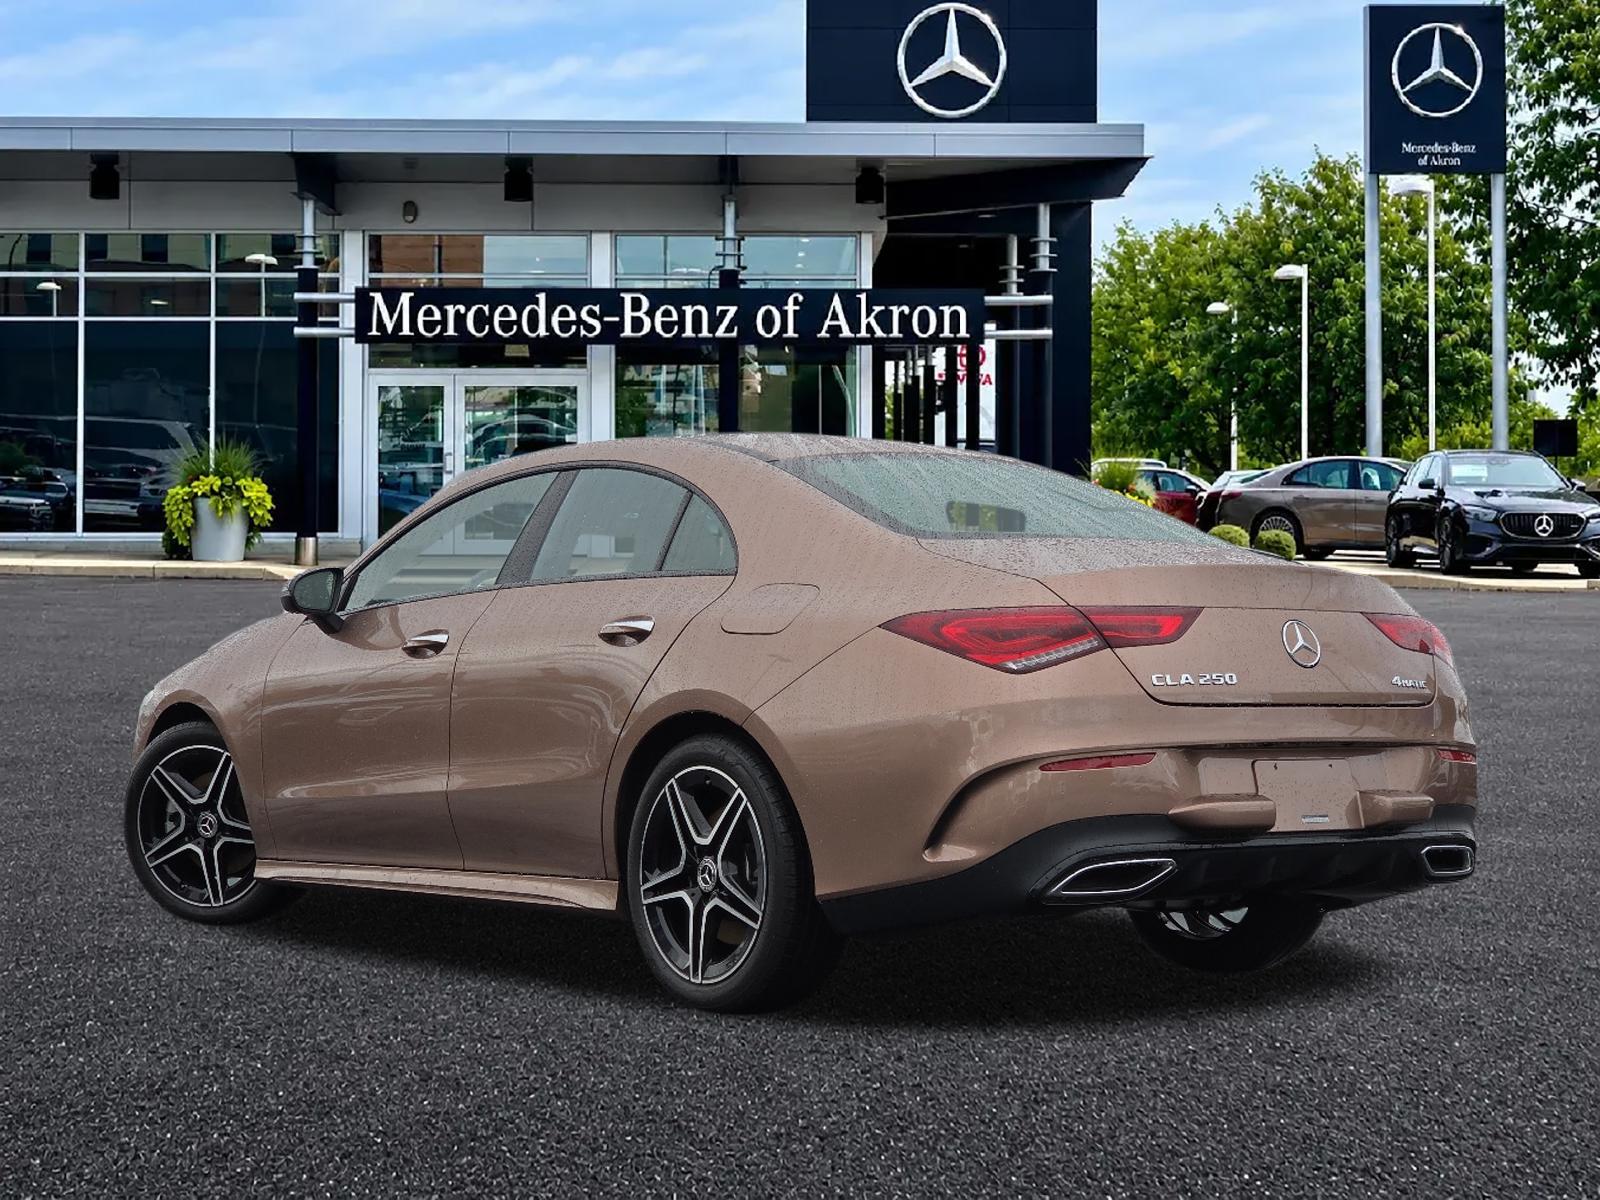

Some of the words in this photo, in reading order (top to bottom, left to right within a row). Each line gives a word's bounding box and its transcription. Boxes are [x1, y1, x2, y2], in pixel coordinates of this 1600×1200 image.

[1401, 142, 1477, 154] Mercedes-Benz
[1417, 154, 1429, 166] of
[1430, 154, 1461, 166] Akron
[367, 292, 738, 338] Mercedes-Benz
[755, 292, 804, 338] of
[817, 292, 970, 338] Akron
[1151, 673, 1195, 686] CLA
[1198, 673, 1238, 686] 250
